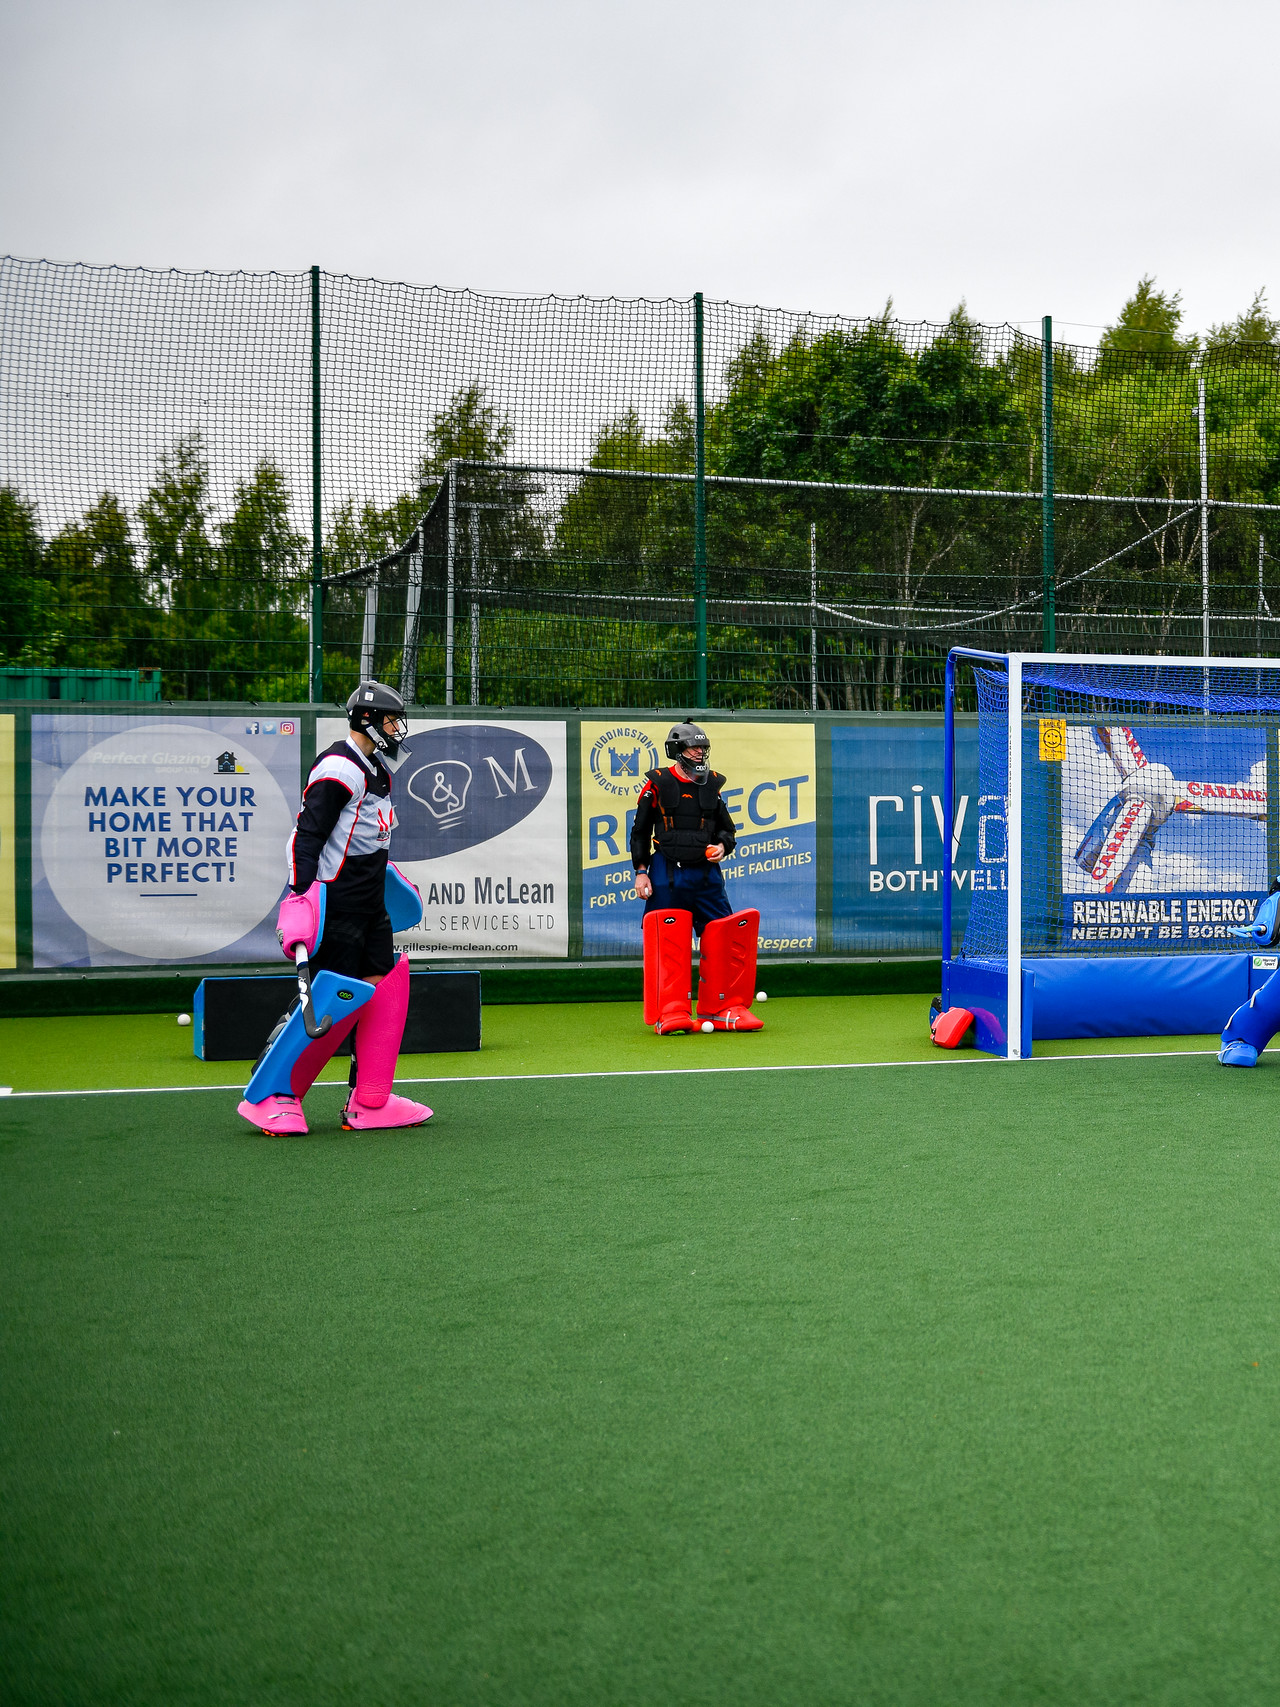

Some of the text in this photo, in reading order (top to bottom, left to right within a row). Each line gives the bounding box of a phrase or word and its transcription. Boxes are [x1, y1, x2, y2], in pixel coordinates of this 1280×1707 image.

[594, 727, 654, 750] UDDINGSTON
[152, 752, 211, 768] Glazing
[483, 748, 538, 799] M
[593, 772, 630, 796] HOCKEY
[84, 786, 257, 807] MAKE YOUR
[1187, 781, 1268, 802] CARAME
[88, 812, 254, 832] HOME THAT
[588, 774, 810, 861] RECT
[104, 837, 237, 858] BIT MORE
[1091, 800, 1145, 881] CARAMEL
[604, 870, 631, 886] FOR
[740, 836, 794, 858] OTHERS,
[748, 851, 813, 876] FACILITIES
[106, 862, 236, 883] PERFECT!
[428, 883, 466, 905] AND
[474, 876, 555, 904] McLean
[589, 892, 617, 909] FOR
[439, 914, 520, 931] SERVICES
[528, 914, 555, 930] LTD
[1073, 899, 1258, 925] RENEWABLE ENERGY
[1072, 926, 1153, 940] NEEDN'T
[1158, 926, 1183, 939] BE
[393, 943, 518, 953] w.gillespie-mclean.com
